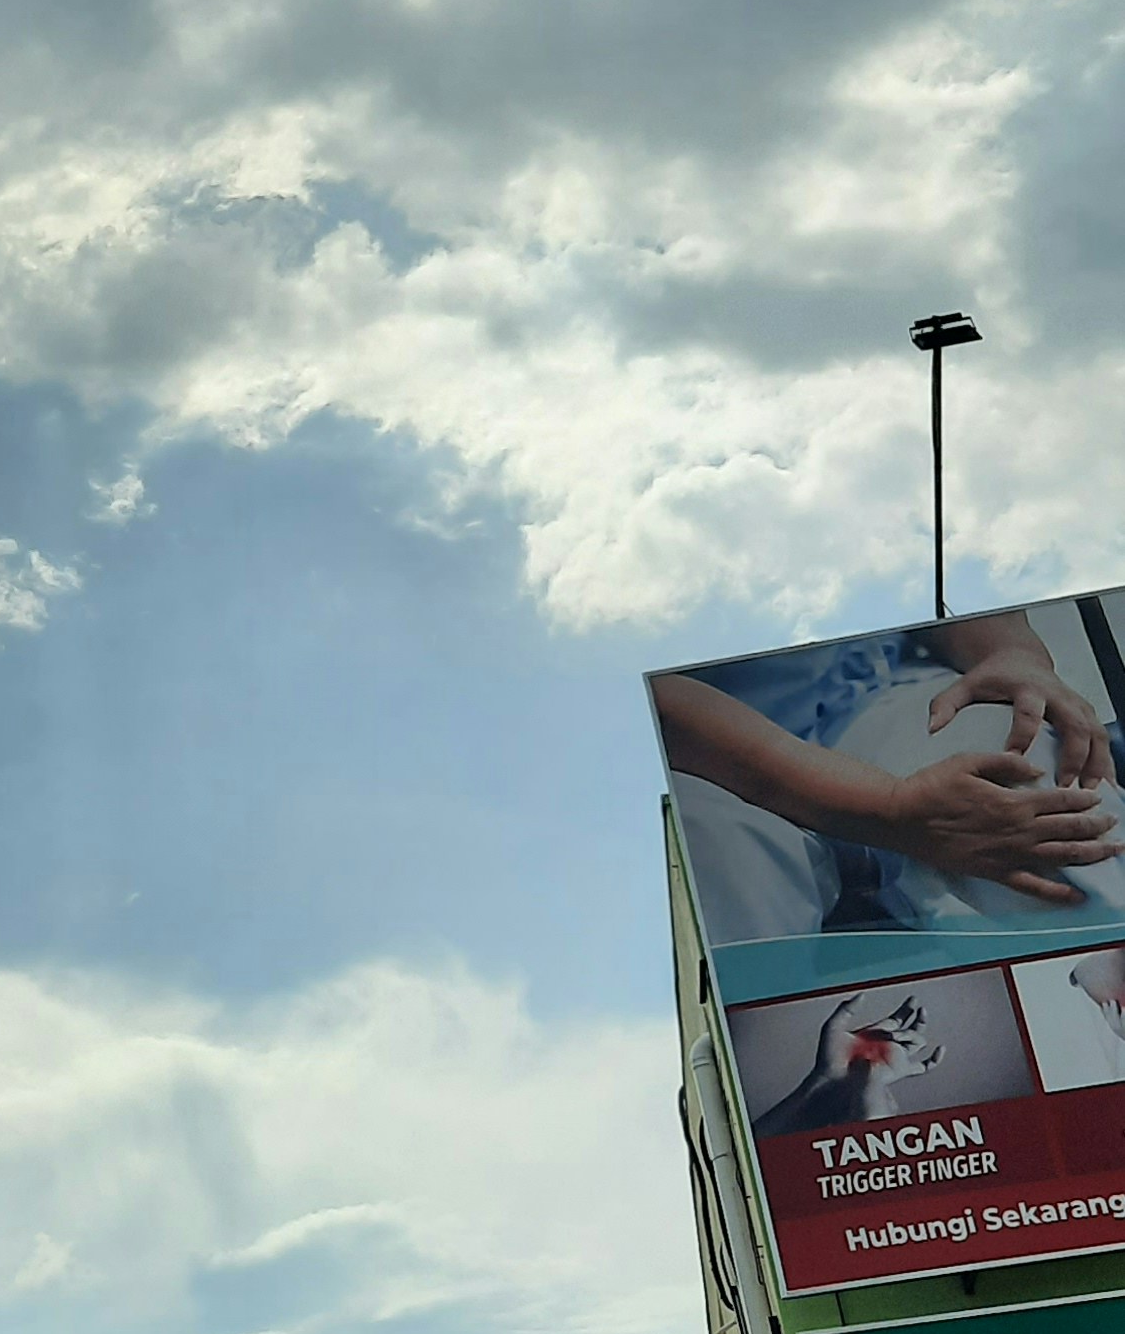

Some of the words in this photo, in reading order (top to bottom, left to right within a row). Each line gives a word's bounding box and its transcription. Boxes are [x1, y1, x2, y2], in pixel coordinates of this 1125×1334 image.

[812, 1116, 985, 1169] TANGAN
[817, 1161, 914, 1200] TRIGGER
[916, 1151, 999, 1185] FINGER
[844, 1209, 978, 1253] Hubungi
[981, 1192, 1125, 1235] Sekarang
